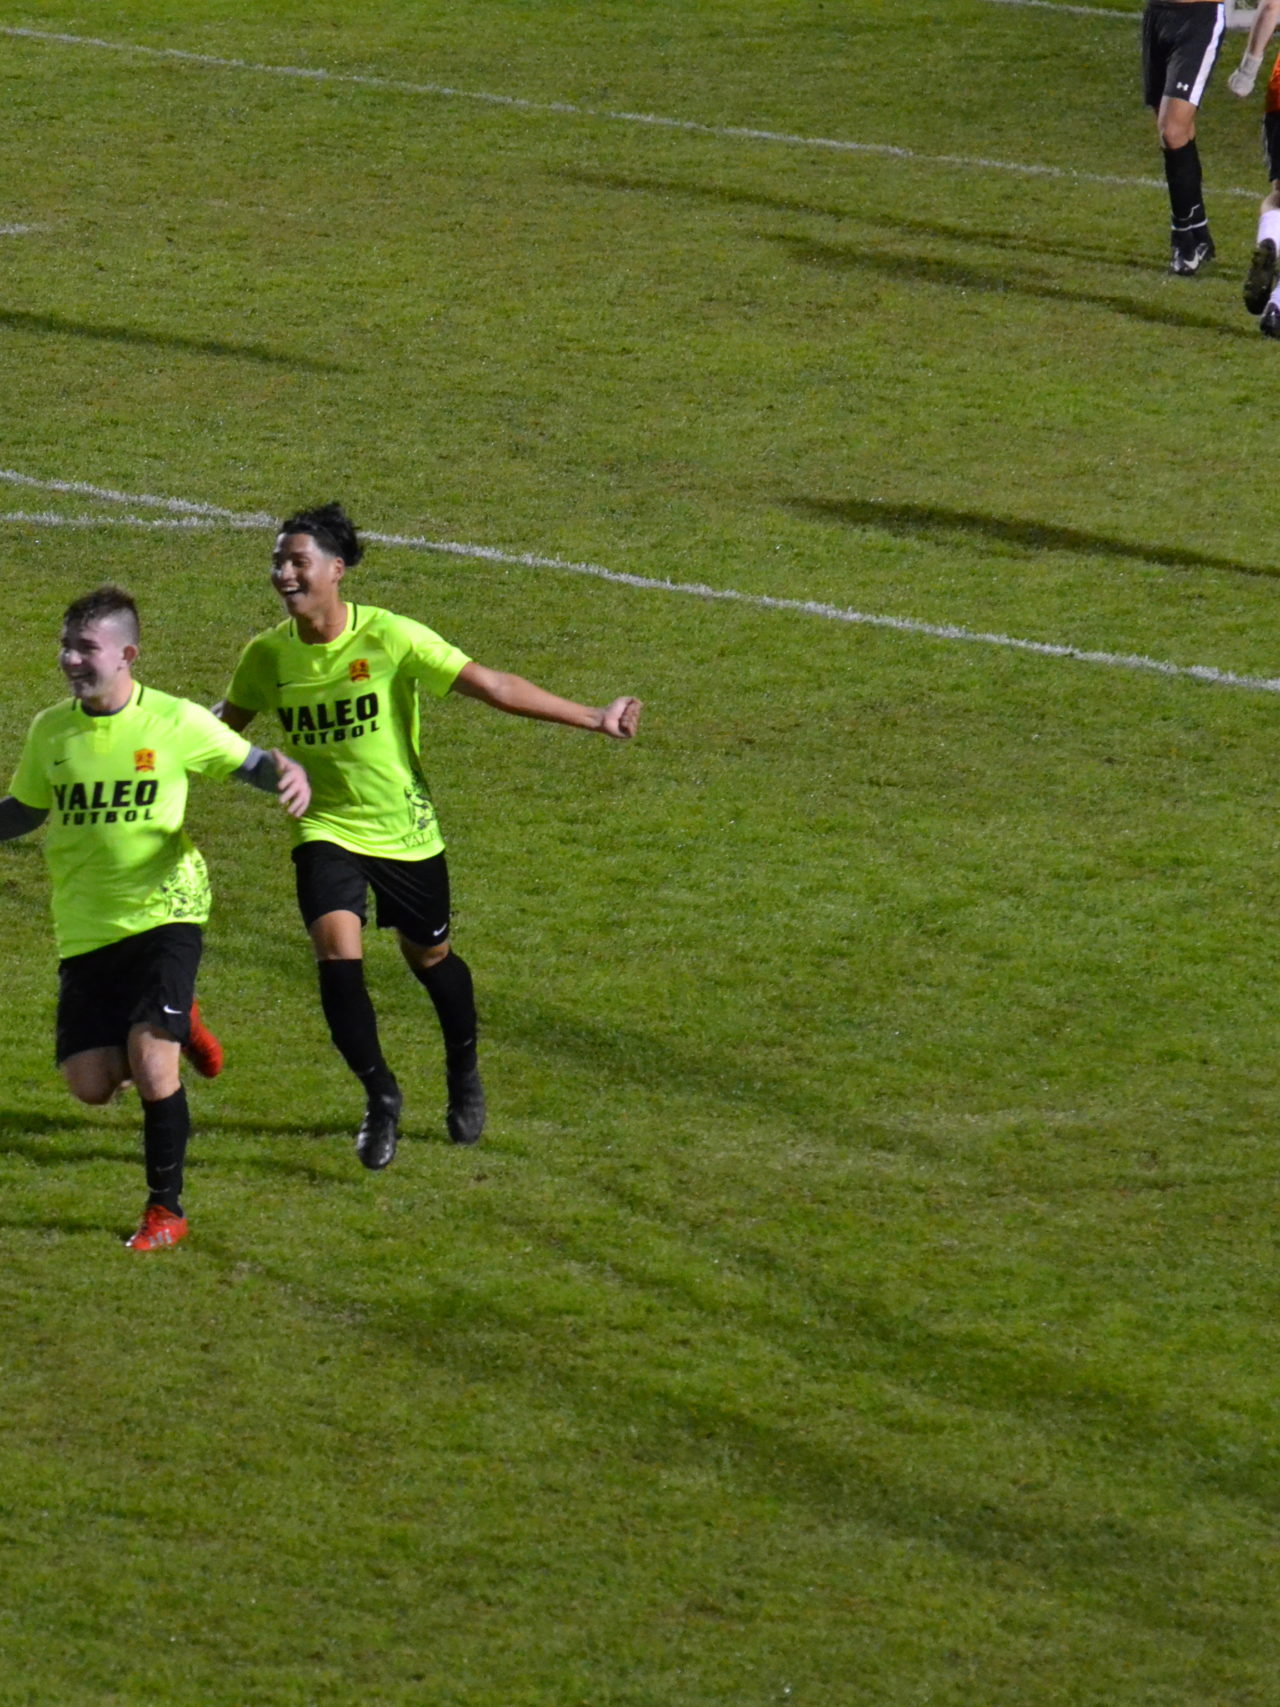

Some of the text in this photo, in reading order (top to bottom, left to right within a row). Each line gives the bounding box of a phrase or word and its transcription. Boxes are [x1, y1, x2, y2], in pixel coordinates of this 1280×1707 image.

[277, 692, 379, 732] VALEO
[292, 720, 380, 745] FUTBOL
[53, 779, 158, 811] VALEO
[62, 808, 154, 826] FUTBOL
